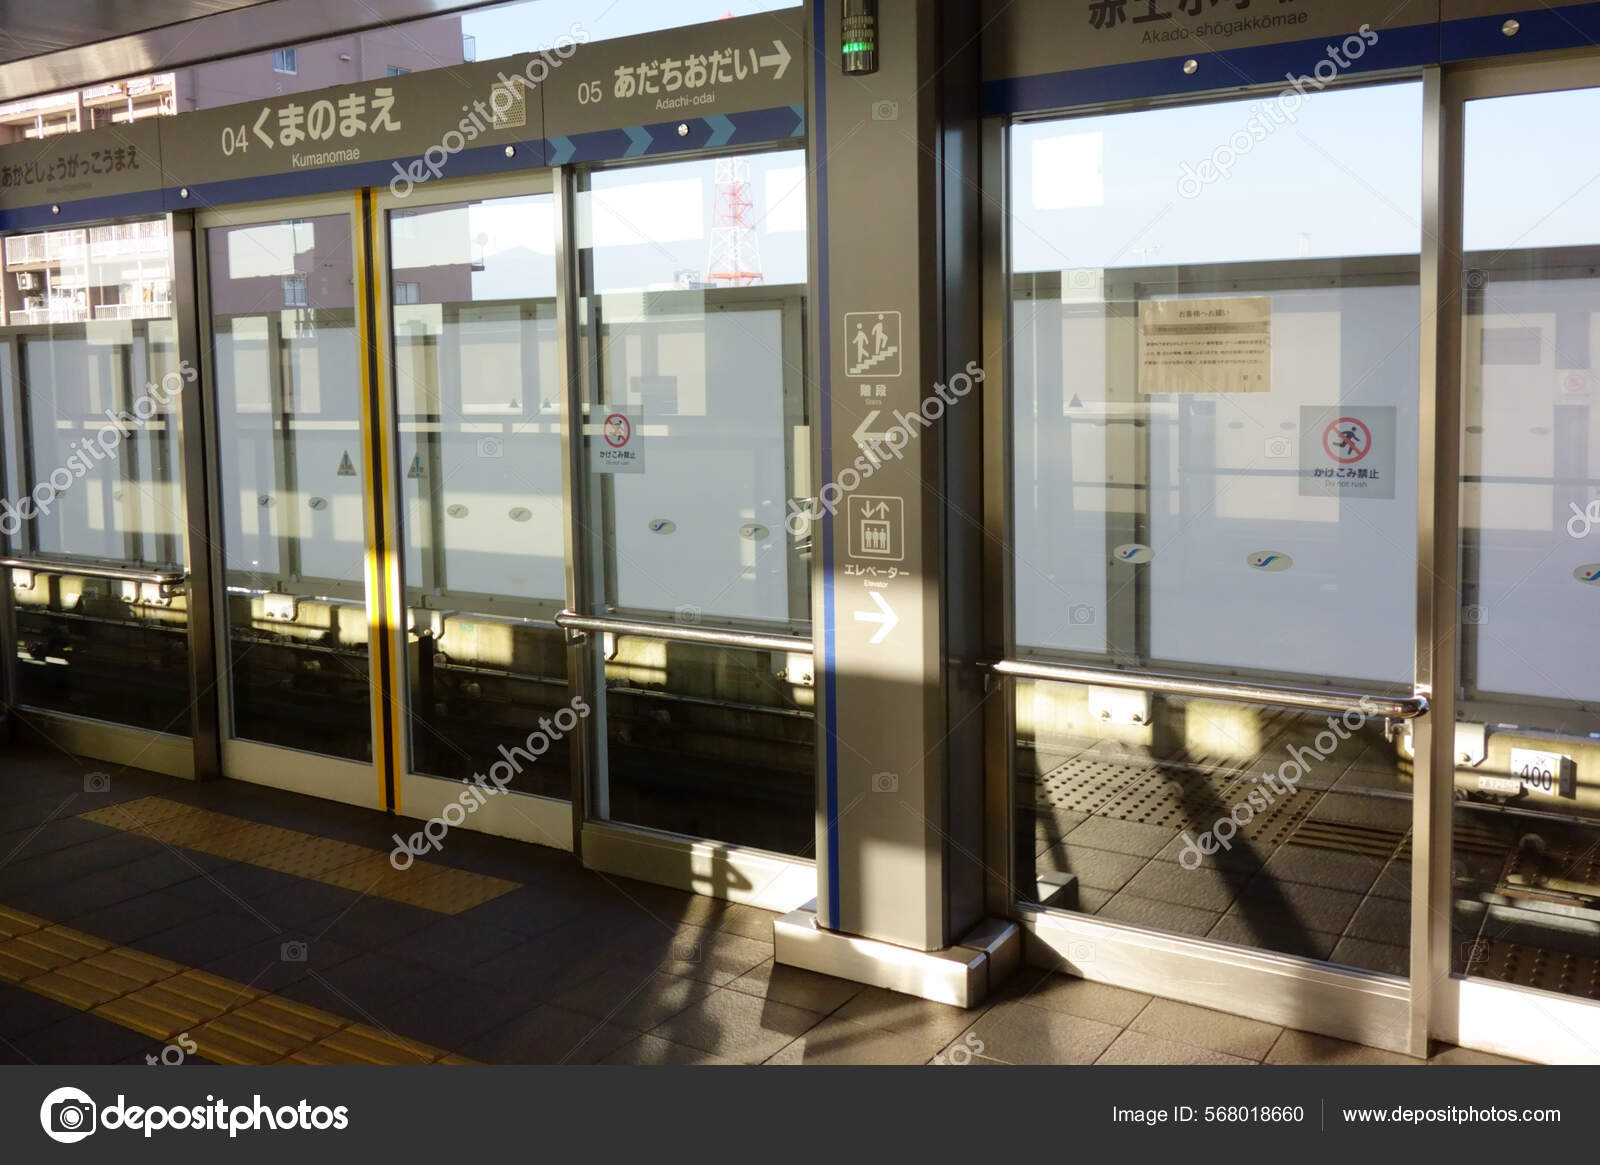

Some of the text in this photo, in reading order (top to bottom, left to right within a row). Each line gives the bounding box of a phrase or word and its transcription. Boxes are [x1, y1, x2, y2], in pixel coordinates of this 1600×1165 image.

[577, 48, 759, 104] 05 あだちおだい
[655, 92, 715, 110] Adachi-odai
[222, 88, 401, 156] 04 くまのまえ
[292, 148, 360, 167] Kumanomae
[1314, 468, 1380, 480] かけこみ禁止
[844, 564, 910, 578] エレベーター
[1520, 764, 1552, 791] 400
